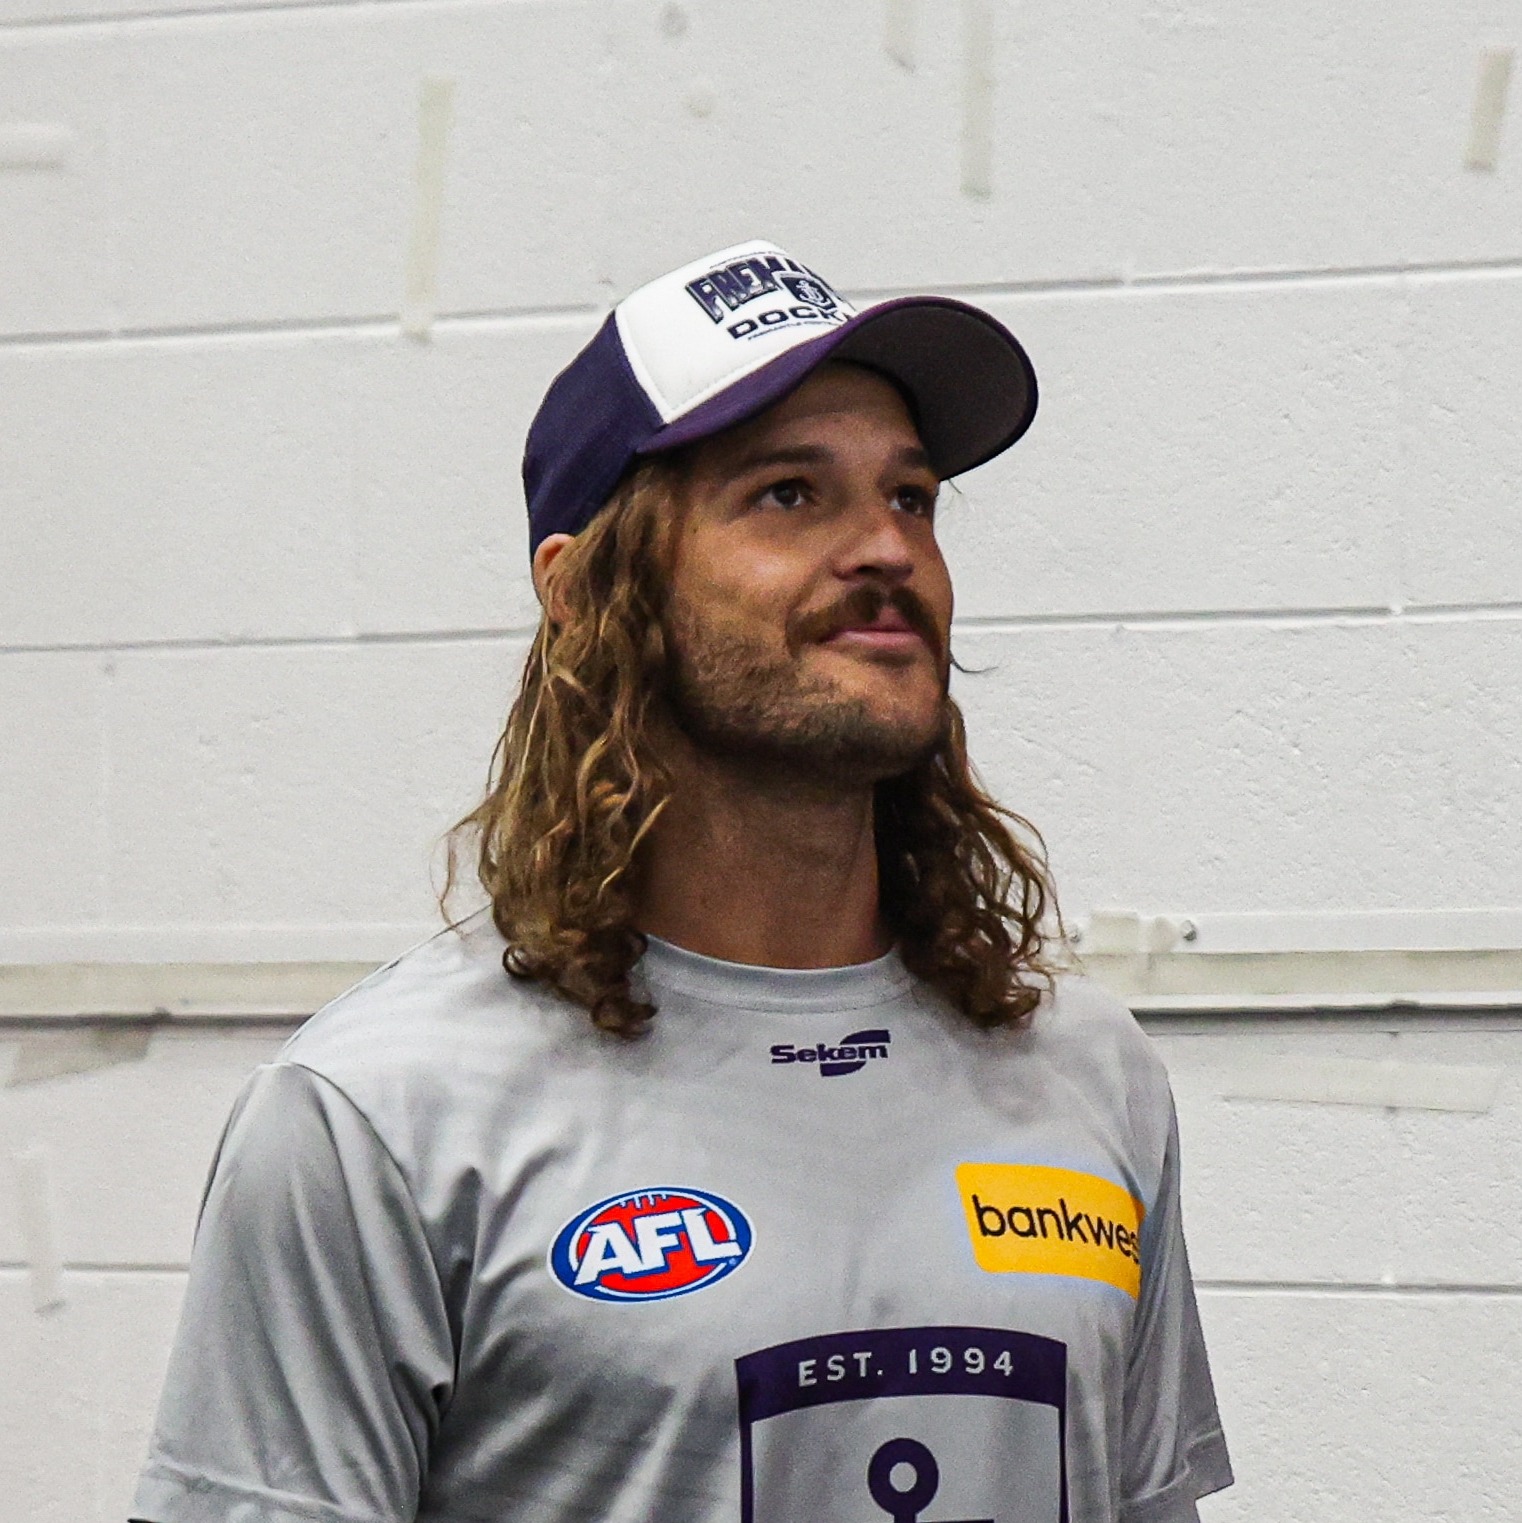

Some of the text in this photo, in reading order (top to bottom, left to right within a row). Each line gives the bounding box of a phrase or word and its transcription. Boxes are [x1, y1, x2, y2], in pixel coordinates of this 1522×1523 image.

[770, 1042, 889, 1064] Sekem
[573, 1206, 743, 1286] AFL
[798, 1346, 1015, 1388] EST. 1994
